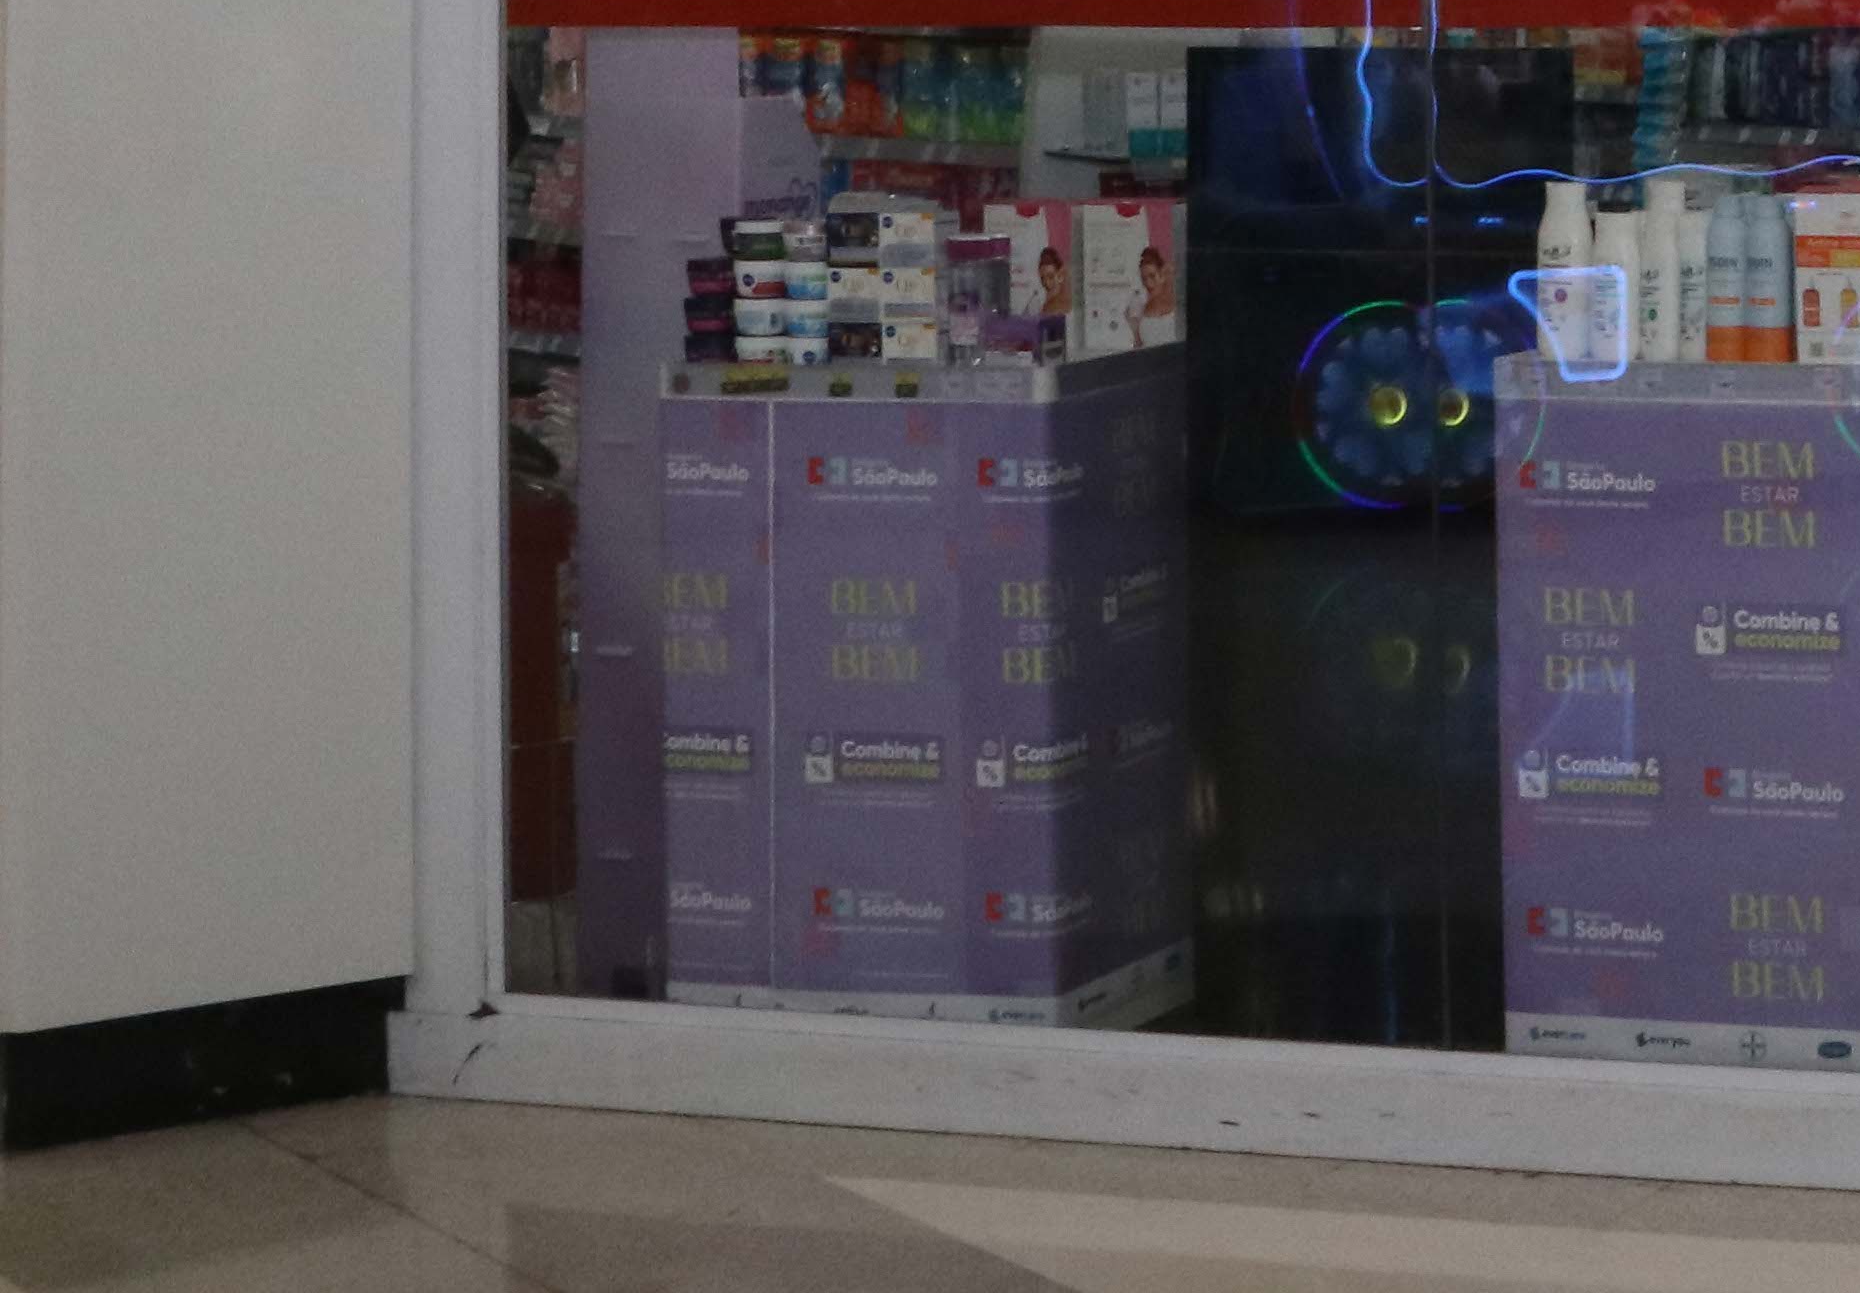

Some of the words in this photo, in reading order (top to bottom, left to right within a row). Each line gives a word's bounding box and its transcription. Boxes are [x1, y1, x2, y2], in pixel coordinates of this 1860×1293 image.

[665, 460, 751, 483] SãoPaulo
[1720, 441, 1816, 480] BEM
[851, 466, 940, 489] SãoPaulo
[1565, 470, 1657, 494] SãoPaulo
[1739, 485, 1800, 503] ESTAR
[1722, 509, 1817, 548] BEM
[1543, 588, 1637, 627] BEM
[1733, 609, 1821, 633] Combine
[1824, 612, 1839, 631] &
[1560, 631, 1620, 650] ESTAR
[1734, 631, 1841, 652] economize
[1544, 654, 1637, 694] BEM
[840, 738, 922, 763] Combine
[925, 741, 941, 762] &
[1556, 755, 1641, 778] Combine
[1643, 756, 1660, 776] &
[1556, 776, 1661, 797] economize
[1752, 780, 1845, 803] SãoPaulo
[1728, 892, 1826, 934] BEM
[1573, 920, 1664, 944] SãoPaulo
[1730, 961, 1826, 1001] BEM
